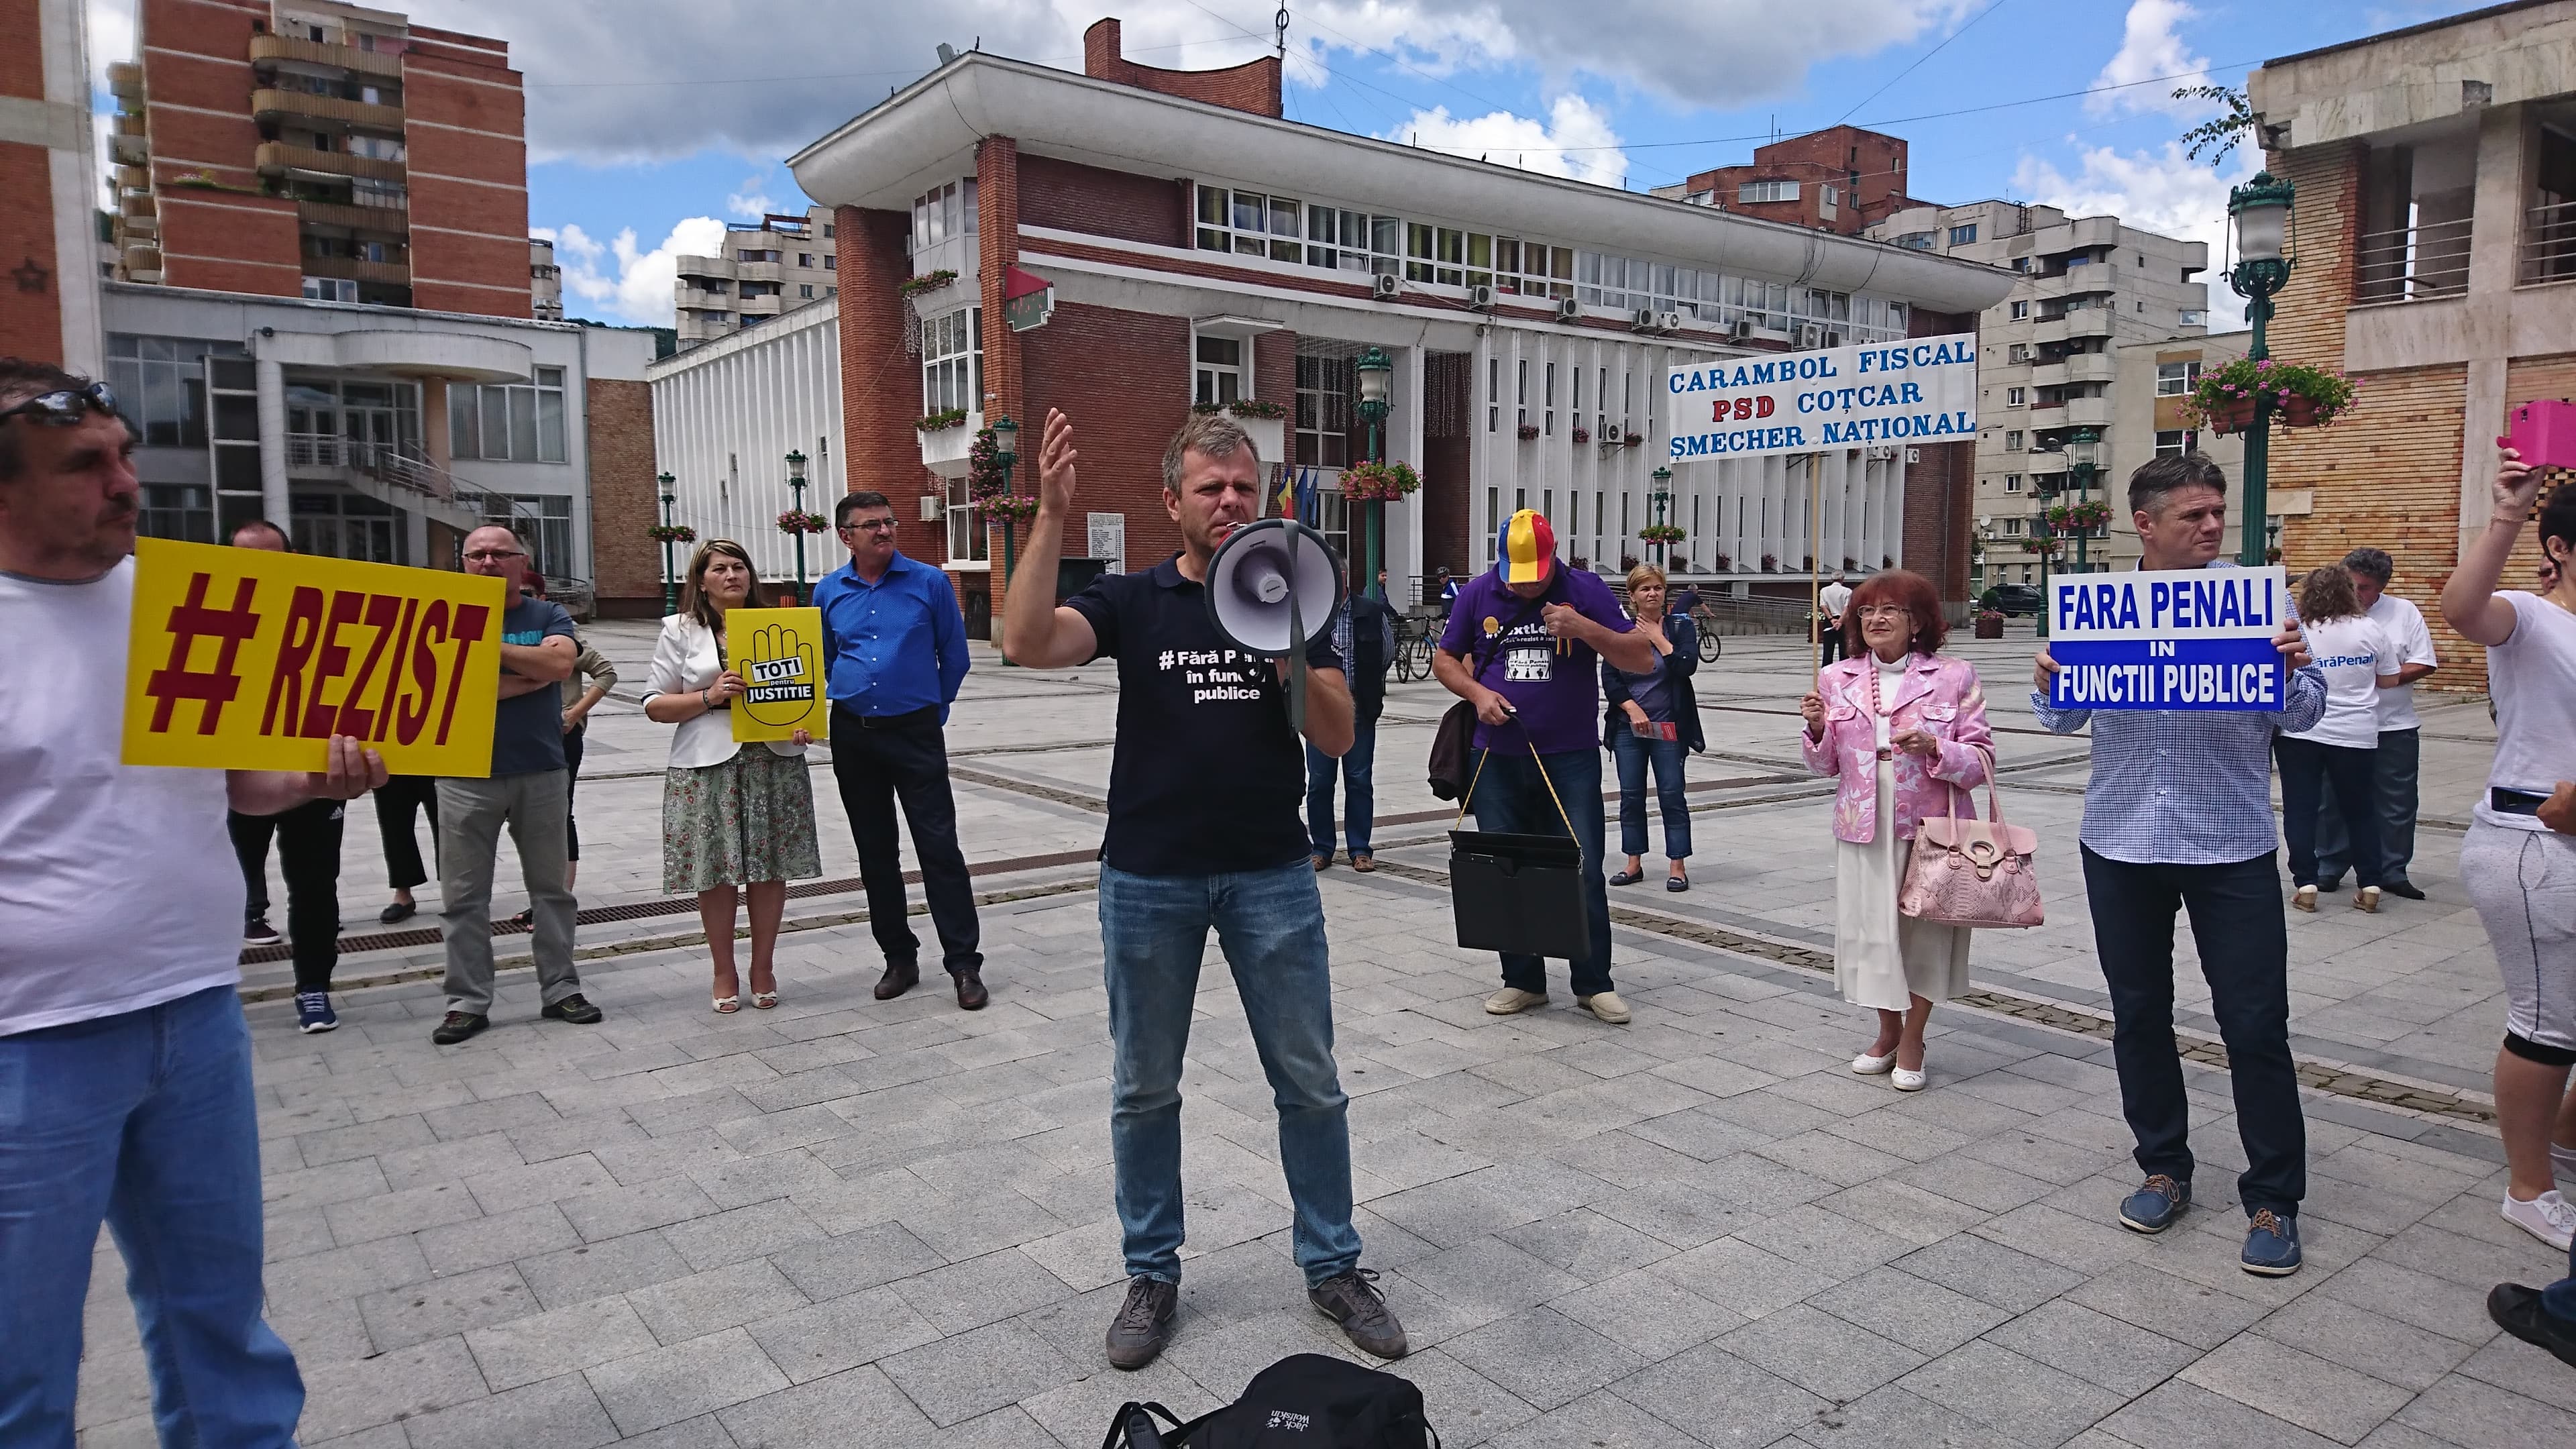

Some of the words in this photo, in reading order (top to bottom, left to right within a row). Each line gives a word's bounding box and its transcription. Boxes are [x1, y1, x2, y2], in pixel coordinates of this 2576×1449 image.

[1669, 356, 1837, 394] CARAMBOL
[1858, 341, 1975, 374] FISCAL
[1712, 394, 1775, 423] PSD
[1798, 382, 1924, 415] COȚCAR
[1670, 425, 1806, 462] ȘMECHER
[1822, 411, 1976, 445] NAȚIONAL
[2058, 584, 2141, 631] FARA
[2151, 578, 2273, 629] PENALI
[2150, 641, 2176, 657] IN
[1159, 650, 1220, 671] #Fără
[1186, 670, 1204, 684] în
[2058, 664, 2155, 702] FUNCTII
[2163, 663, 2275, 704] PUBLICE
[749, 686, 812, 703] JUSTITIE
[1194, 686, 1261, 704] publice
[1271, 1410, 1310, 1424] Wolfskin
[1284, 1421, 1308, 1432] Jack
